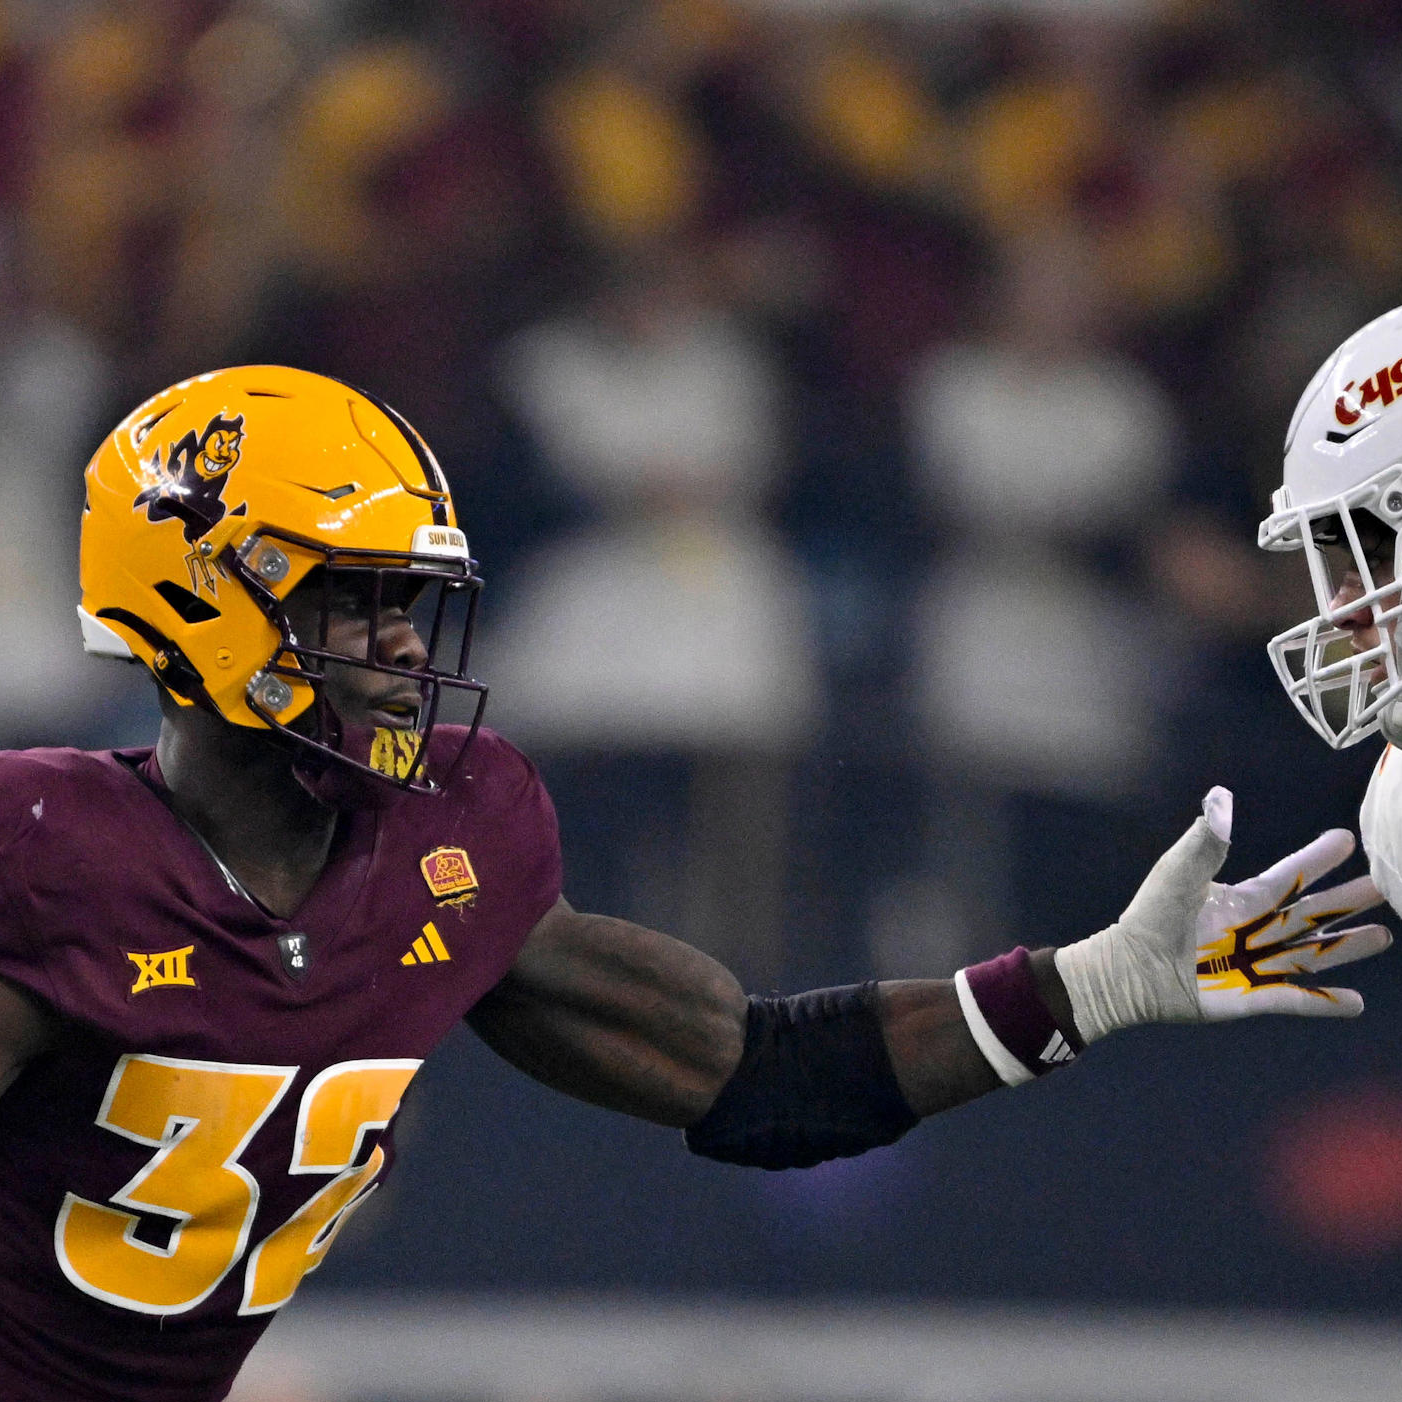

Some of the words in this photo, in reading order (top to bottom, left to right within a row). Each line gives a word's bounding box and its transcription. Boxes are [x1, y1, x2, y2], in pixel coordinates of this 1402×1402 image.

[428, 531, 447, 545] SUN
[288, 938, 300, 951] PT
[291, 955, 303, 967] 42
[126, 944, 196, 994] XII
[54, 1053, 425, 1317] 32
